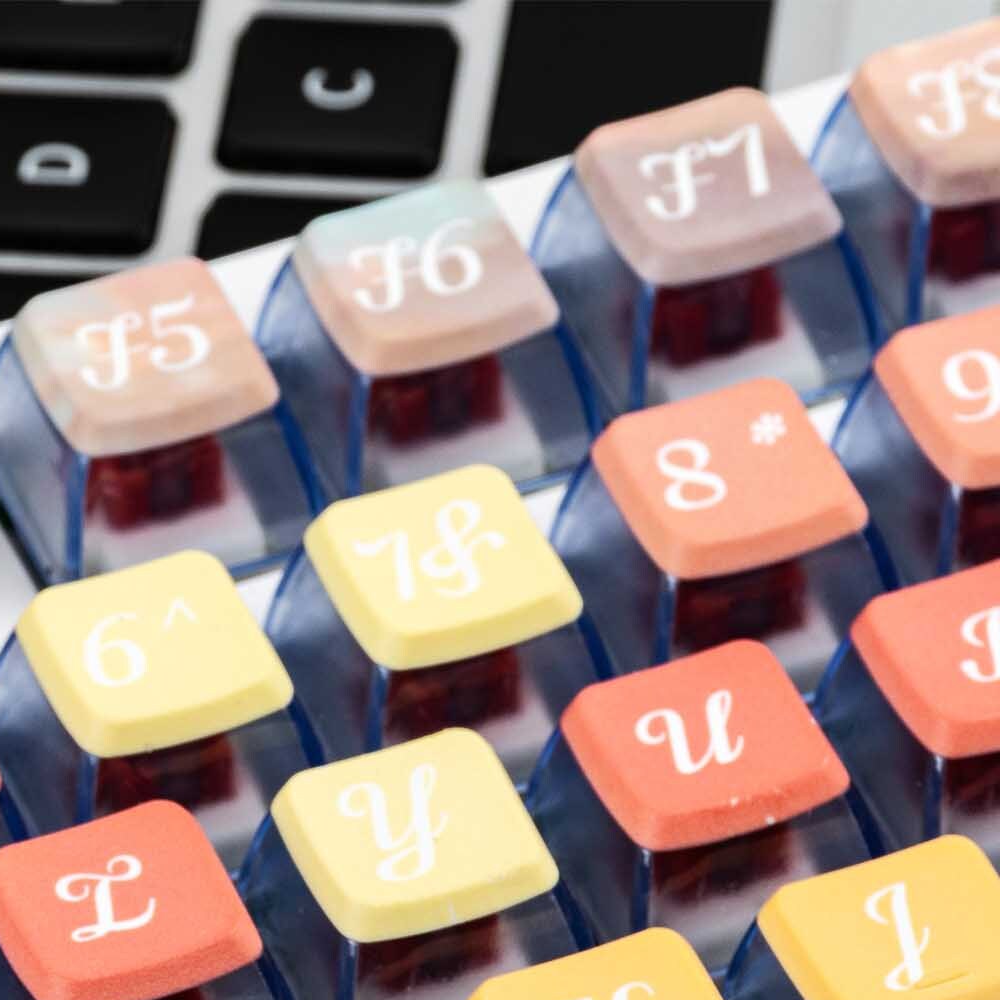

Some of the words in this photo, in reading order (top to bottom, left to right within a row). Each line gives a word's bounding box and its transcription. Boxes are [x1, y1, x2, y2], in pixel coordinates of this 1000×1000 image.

[303, 67, 374, 110] C
[17, 143, 90, 185] D
[640, 124, 770, 219] F7
[350, 218, 483, 311] F6
[74, 294, 210, 389] F5
[943, 349, 1000, 423] 9
[655, 439, 727, 510] 8
[634, 690, 745, 775] U
[338, 764, 448, 882] Y
